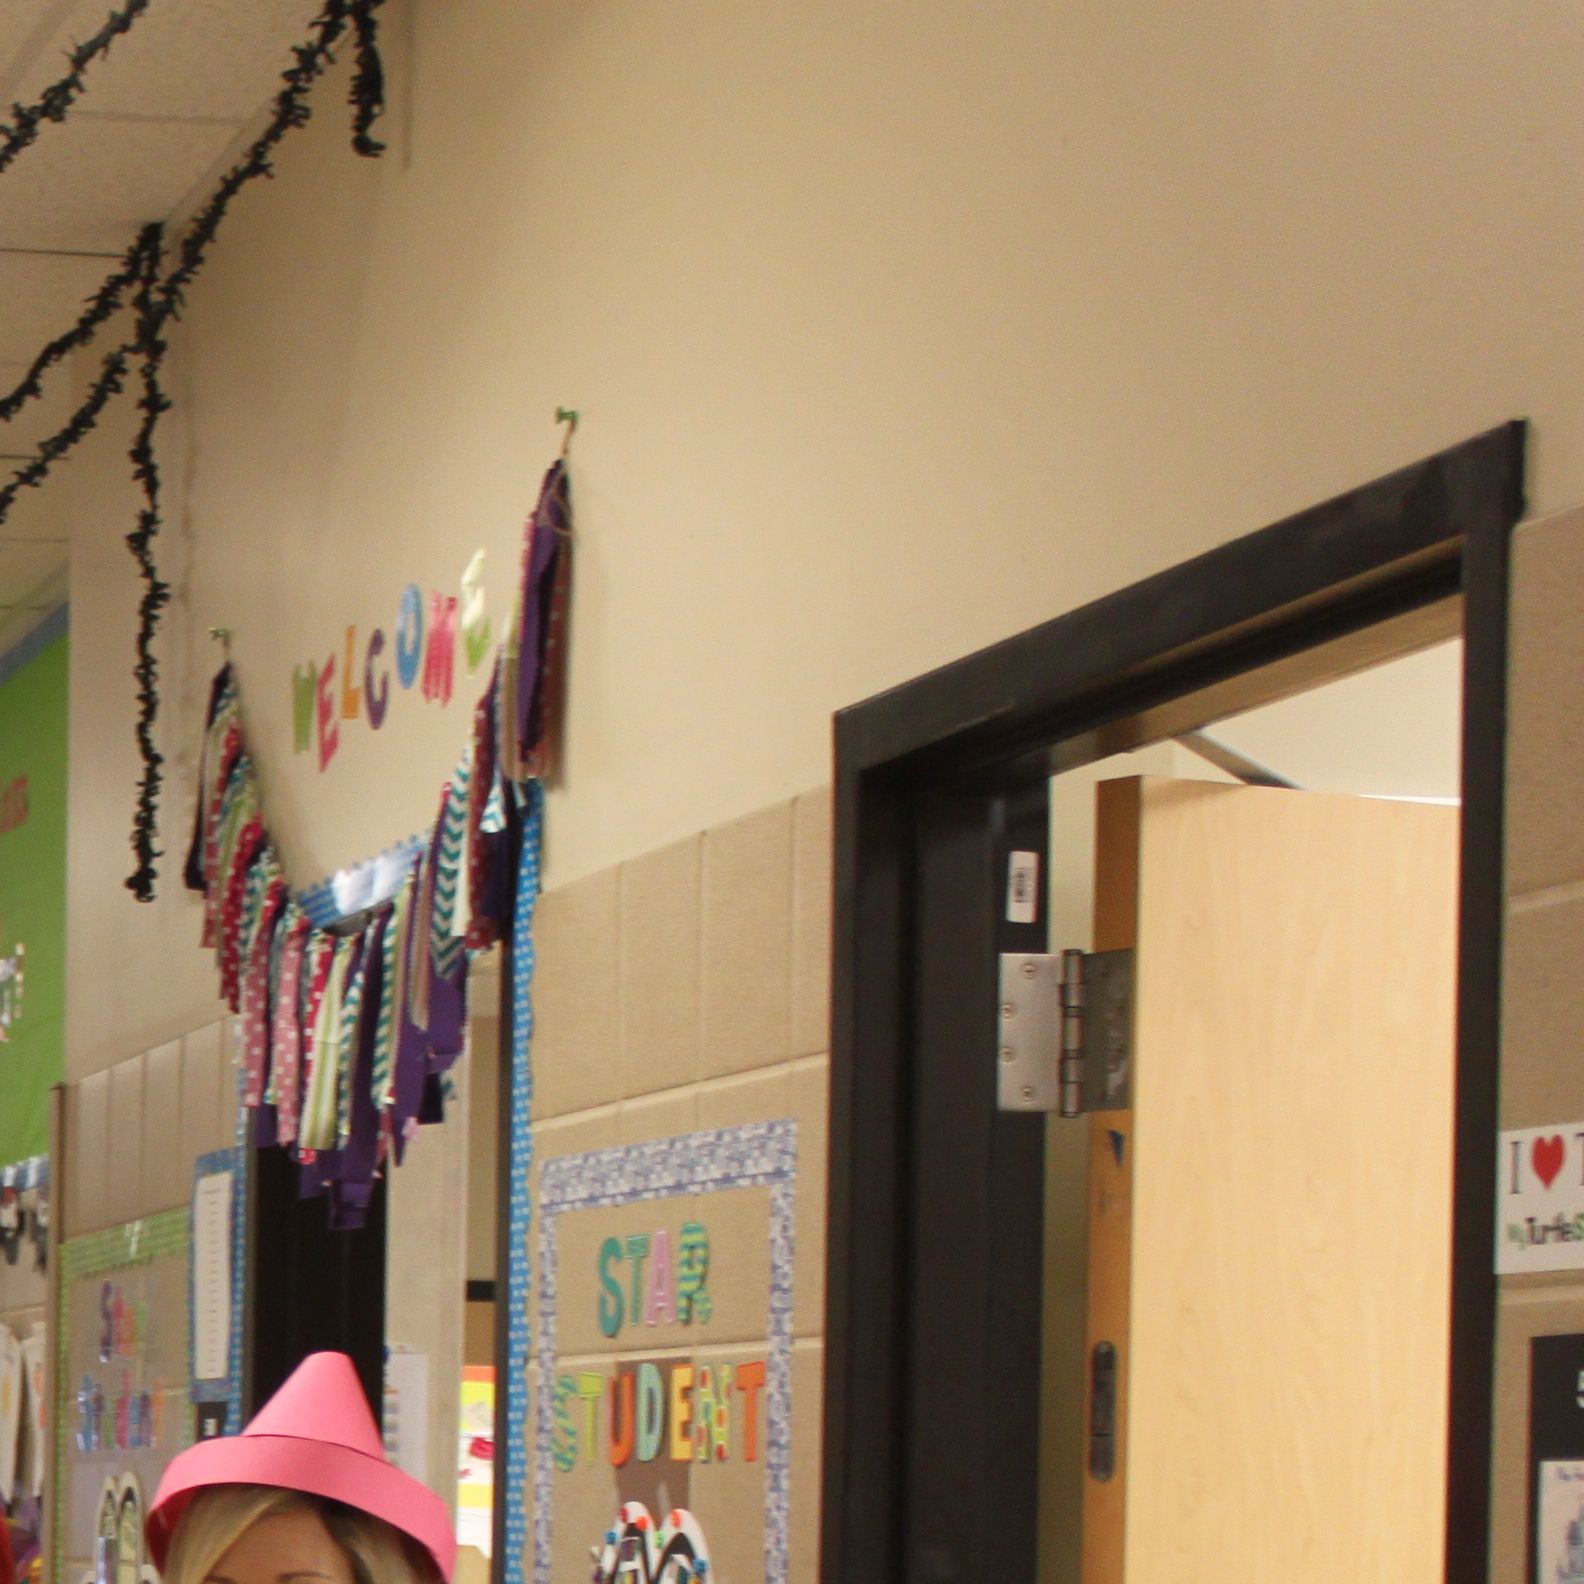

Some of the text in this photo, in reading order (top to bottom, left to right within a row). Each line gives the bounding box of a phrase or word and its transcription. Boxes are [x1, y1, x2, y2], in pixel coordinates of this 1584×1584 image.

[291, 548, 493, 774] WELCOME
[598, 1222, 714, 1339] STAR
[552, 1360, 766, 1473] STUDENT
